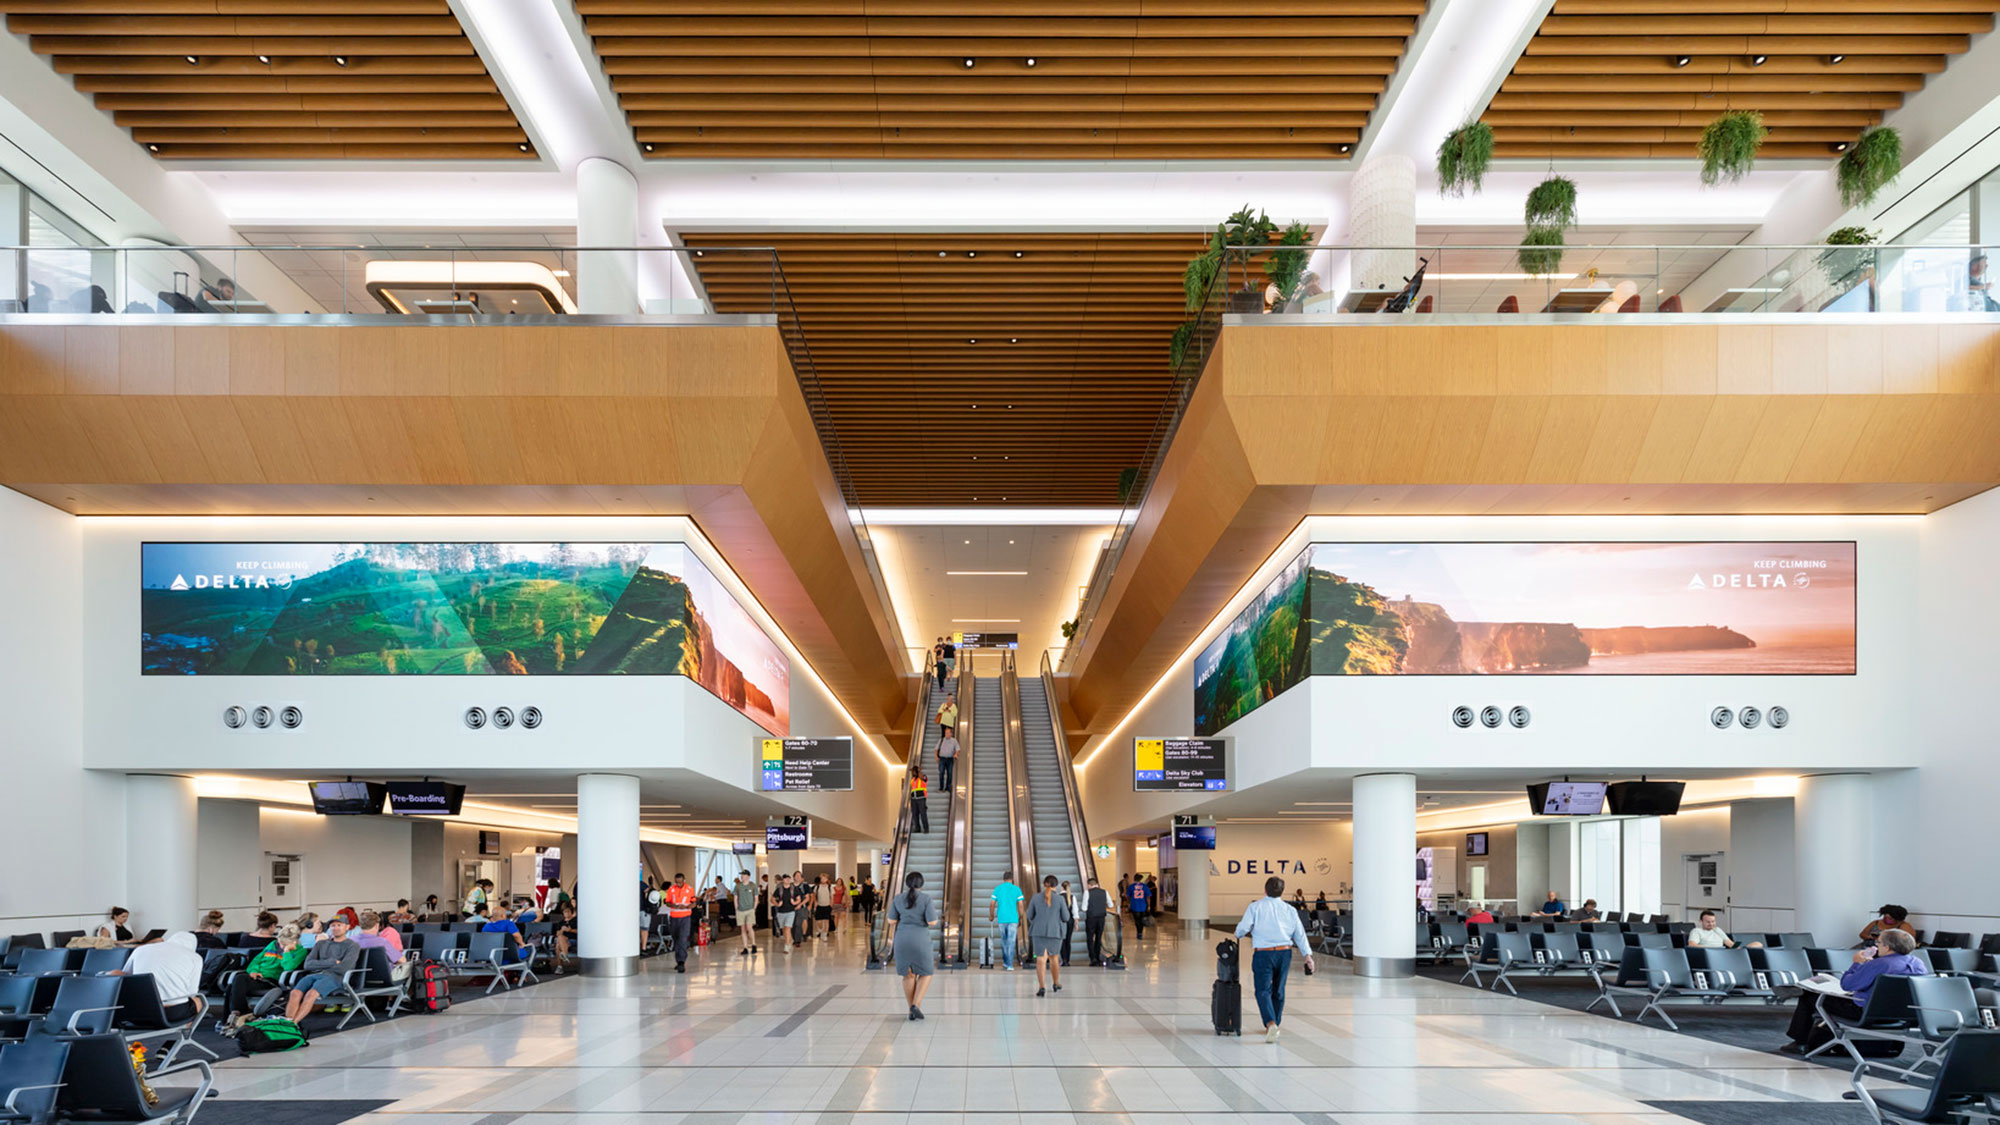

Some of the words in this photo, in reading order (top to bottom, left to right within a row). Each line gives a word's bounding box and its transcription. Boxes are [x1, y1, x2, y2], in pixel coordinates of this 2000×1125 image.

[236, 561, 259, 569] KEEP
[261, 561, 308, 569] CLIMBING
[1754, 560, 1776, 568] KEEP
[1779, 560, 1826, 568] CLIMBING
[195, 574, 270, 589] DELTA
[1712, 574, 1787, 587] DELTA
[392, 794, 446, 804] Pre-Boarding
[789, 816, 802, 825] 72
[1182, 816, 1192, 824] 71
[767, 833, 805, 842] Pittsburgh
[1228, 860, 1306, 874] DELTA
